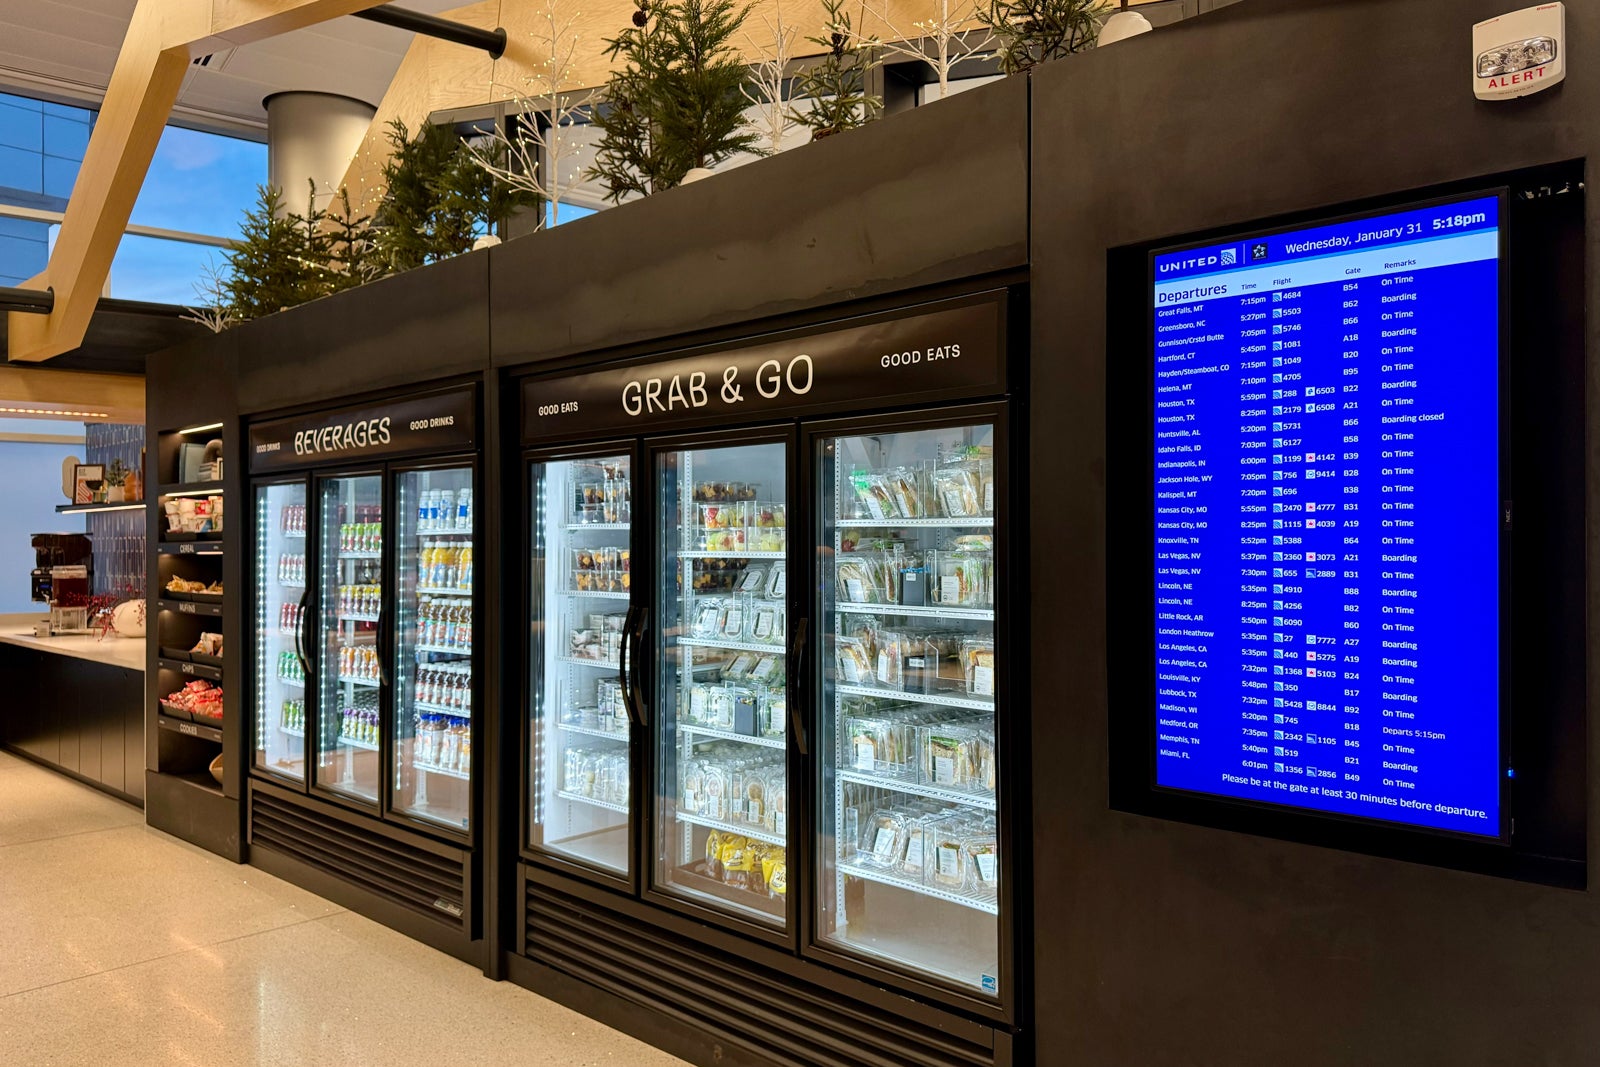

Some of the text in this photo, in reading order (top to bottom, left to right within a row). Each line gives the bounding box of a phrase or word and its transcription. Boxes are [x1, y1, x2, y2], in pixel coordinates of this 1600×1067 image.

[1488, 67, 1546, 88] ALERT
[1285, 213, 1485, 254] Wednesday, January 31 5:18pm
[1160, 256, 1217, 273] UNITED
[1384, 259, 1416, 269] Remarks
[1158, 309, 1175, 317] Great
[1241, 297, 1266, 305] 7:15pm
[1283, 291, 1301, 299] 4684
[1343, 283, 1358, 291] B54
[1381, 278, 1392, 286] On
[1394, 276, 1414, 284] Time
[1159, 284, 1227, 303] Departures
[1158, 322, 1195, 332] Greensboro,
[1240, 313, 1266, 322] 5:27pm
[1283, 307, 1301, 316] 5503
[1343, 300, 1358, 308] B62
[1381, 293, 1417, 303] Boarding
[1241, 329, 1266, 337] 7:05pm
[1283, 324, 1302, 332] 5746
[1343, 316, 1359, 325] B66
[1381, 313, 1392, 321] On
[882, 345, 960, 367] GOOD EATS
[1241, 361, 1266, 369] 7:15pm
[1284, 357, 1302, 365] 1049
[1343, 350, 1359, 359] B20
[1381, 347, 1393, 355] On
[622, 354, 814, 416] GRAB & GO
[1158, 400, 1185, 408] Houston,
[1240, 393, 1267, 401] 5:59pm
[1316, 386, 1335, 395] 6503
[1343, 384, 1358, 392] B22
[1382, 380, 1417, 389] Boarding
[539, 402, 578, 415] GOOD EATS
[410, 416, 453, 430] GOOD DRINKS
[1158, 430, 1191, 438] Huntsville,
[1241, 425, 1266, 433] 5:20pm
[1283, 422, 1301, 430] 5731
[1343, 418, 1359, 426] B66
[1382, 415, 1417, 424] Boarding
[1418, 413, 1444, 421] closed
[295, 417, 390, 455] BEVERAGES
[1240, 457, 1266, 465] 6:00pm
[1316, 453, 1335, 461] 4142
[1343, 452, 1359, 460] B39
[1316, 503, 1336, 511] 4777
[1344, 503, 1358, 511] B31
[1241, 553, 1267, 561] 5:37pm
[1284, 553, 1302, 561] 2360
[1382, 554, 1417, 563] Boarding
[1241, 585, 1267, 593] 5:35pm
[1382, 589, 1417, 598] Boarding
[1176, 613, 1193, 621] Rock,
[1241, 616, 1267, 625] 5:50pm
[1284, 618, 1303, 626] 6090
[1344, 621, 1359, 629] B60
[1395, 624, 1415, 632] Time
[1183, 629, 1214, 637] Heathrow
[1241, 633, 1267, 641] 5:35pm
[1344, 638, 1360, 646] A27
[1382, 640, 1418, 651] Boarding
[1159, 673, 1190, 682] Louisville,
[1242, 680, 1268, 689] 5:48pm
[1284, 684, 1298, 692] 350
[1344, 689, 1360, 697] B17
[1382, 692, 1418, 703] Boarding
[1159, 703, 1187, 713] Madison,
[1242, 712, 1268, 721] 5:20pm
[1284, 716, 1299, 724] 745
[1344, 723, 1360, 731] B18
[1383, 727, 1413, 736] Departs
[1415, 730, 1445, 739] 5:15pm
[1160, 749, 1181, 758] Miami,
[1242, 760, 1268, 769] 6:01pm
[1285, 765, 1303, 774] 1356
[1317, 769, 1337, 779] 2856
[1344, 773, 1360, 782] B49
[1383, 778, 1394, 786] On
[1395, 780, 1415, 789] Time
[1222, 773, 1488, 819] Please be at the gate at least 30 minutes before departure.
